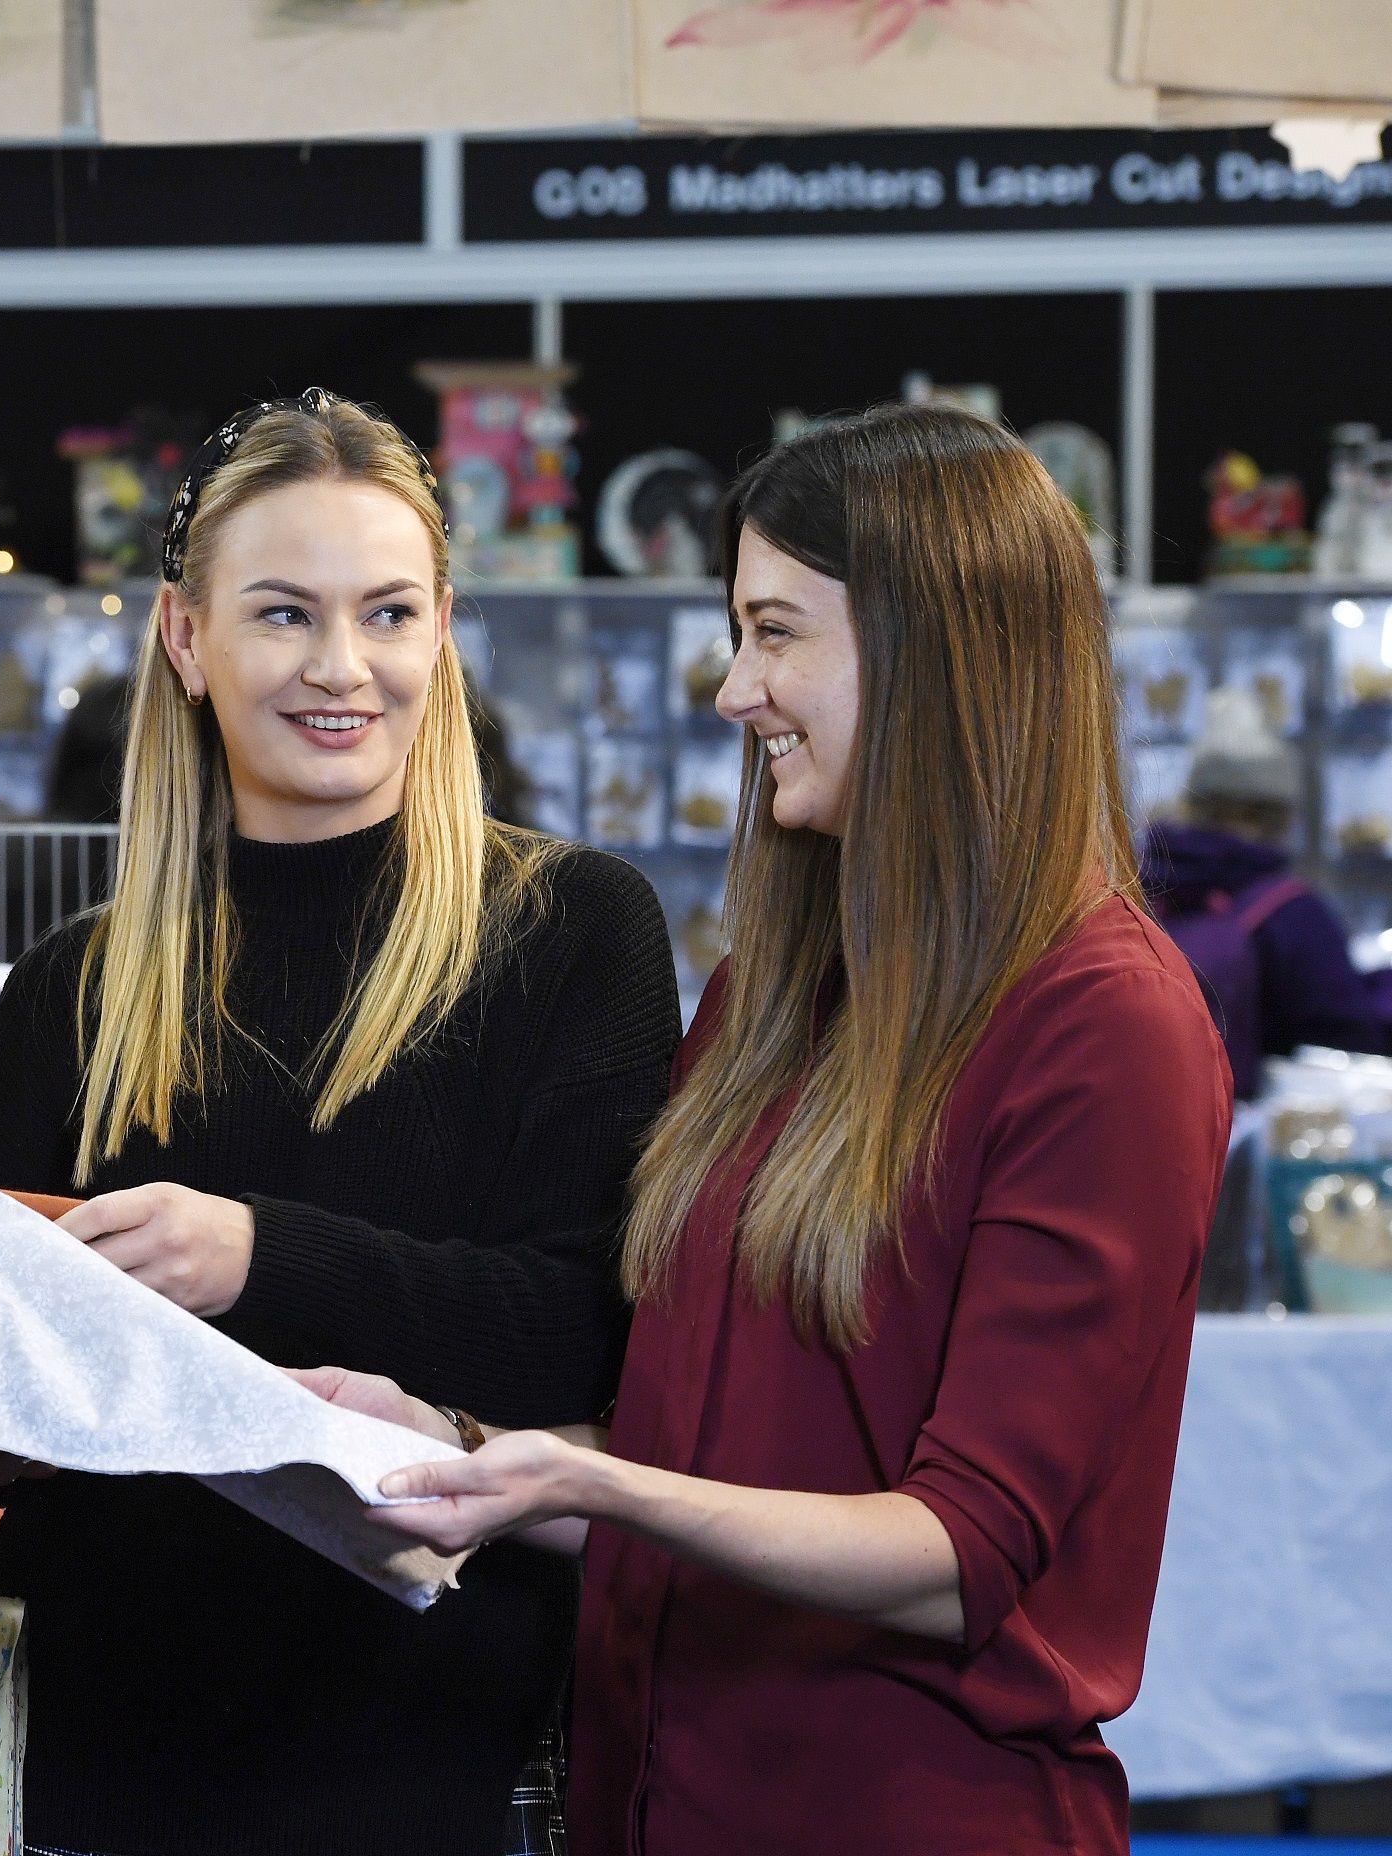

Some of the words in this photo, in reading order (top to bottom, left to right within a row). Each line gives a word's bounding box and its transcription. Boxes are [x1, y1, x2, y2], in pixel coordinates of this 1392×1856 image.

[669, 161, 942, 213] Madhatters
[958, 159, 1098, 207] Laser
[1111, 151, 1201, 203] Cut
